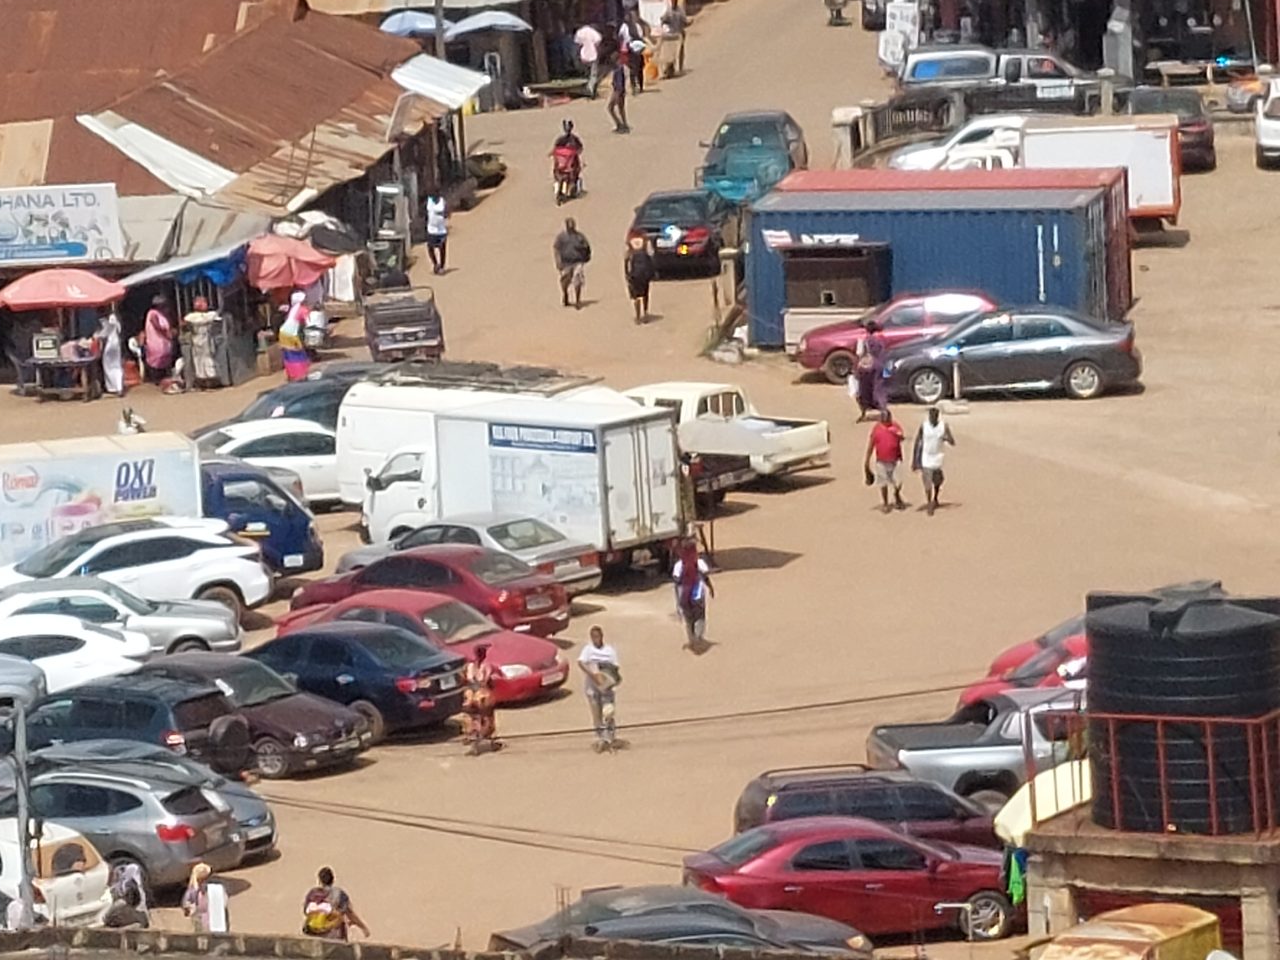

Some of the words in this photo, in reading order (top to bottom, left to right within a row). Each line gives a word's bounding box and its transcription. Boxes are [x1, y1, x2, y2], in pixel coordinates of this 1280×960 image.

[62, 192, 101, 208] LTD.
[116, 458, 154, 488] OXI
[114, 486, 157, 503] POWER
